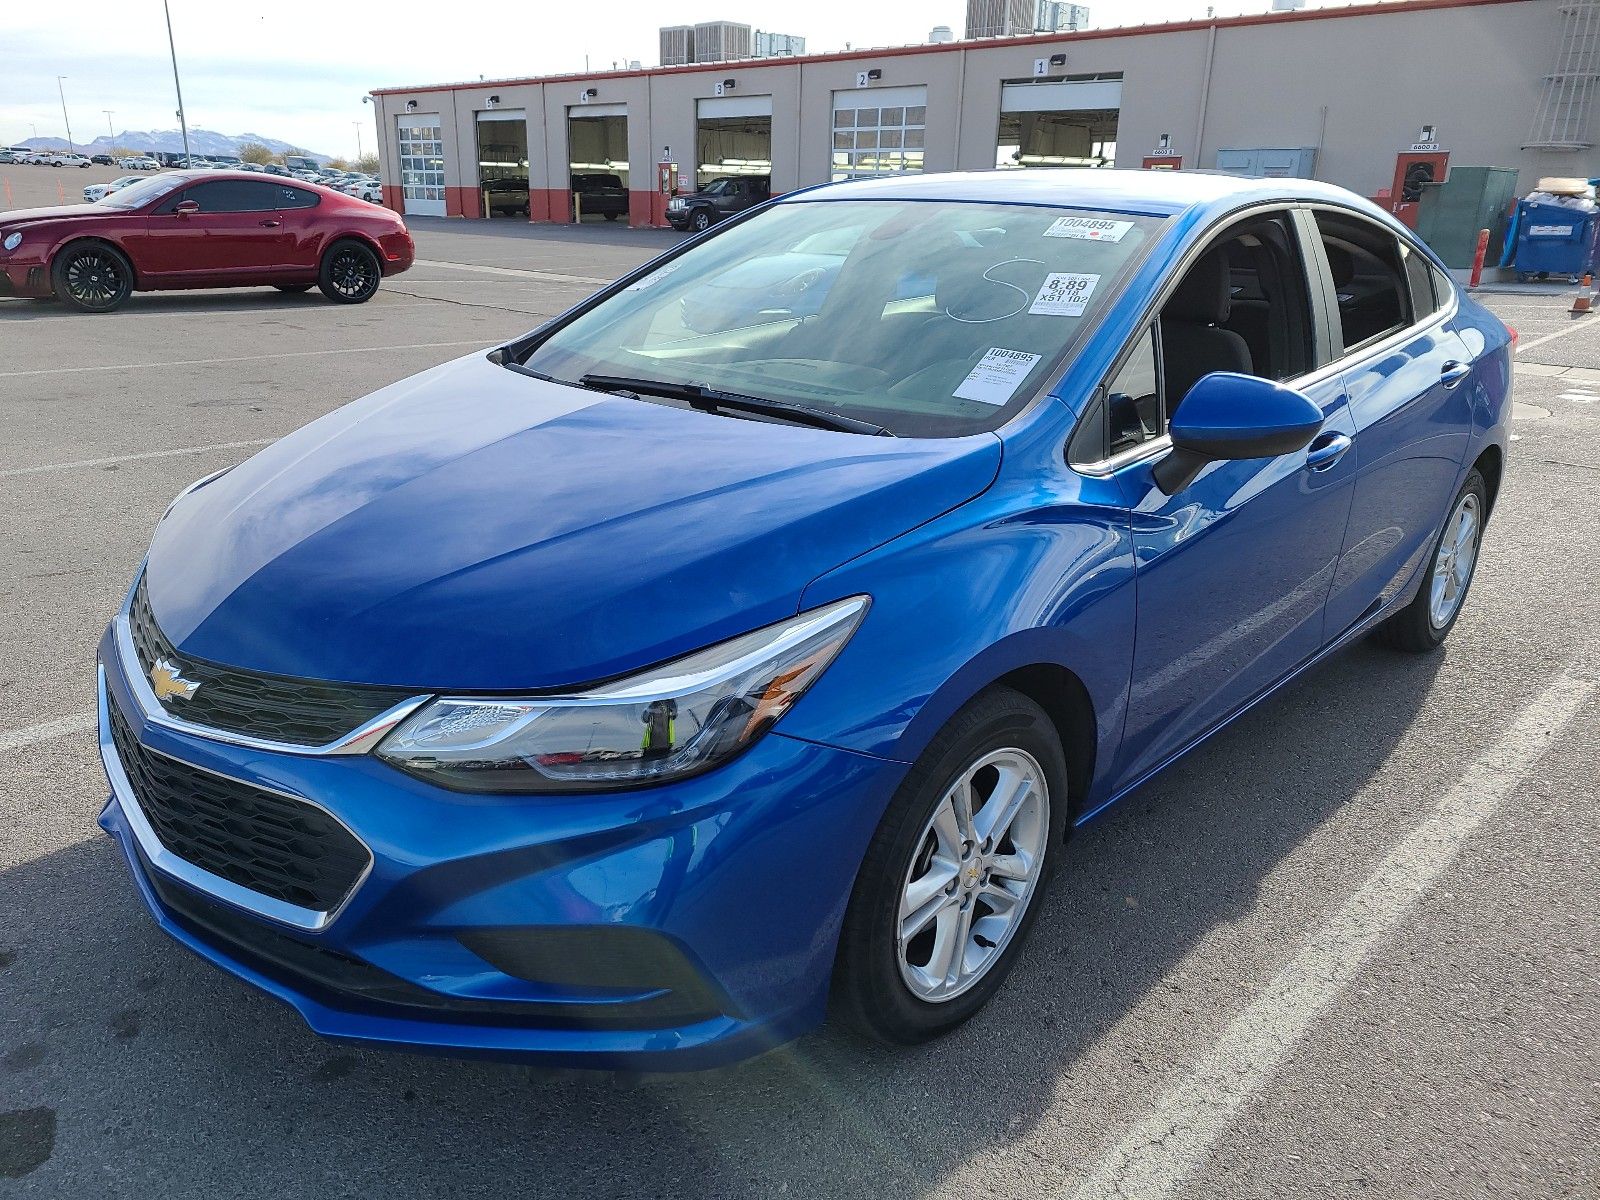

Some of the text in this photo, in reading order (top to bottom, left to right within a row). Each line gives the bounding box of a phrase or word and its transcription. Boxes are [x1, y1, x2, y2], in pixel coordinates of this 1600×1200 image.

[1038, 61, 1043, 73] 1
[860, 74, 865, 85] 2
[1059, 218, 1116, 230] 1004895
[1048, 279, 1088, 291] 8-89
[1051, 289, 1079, 297] 2018
[990, 348, 1034, 362] 1004895
